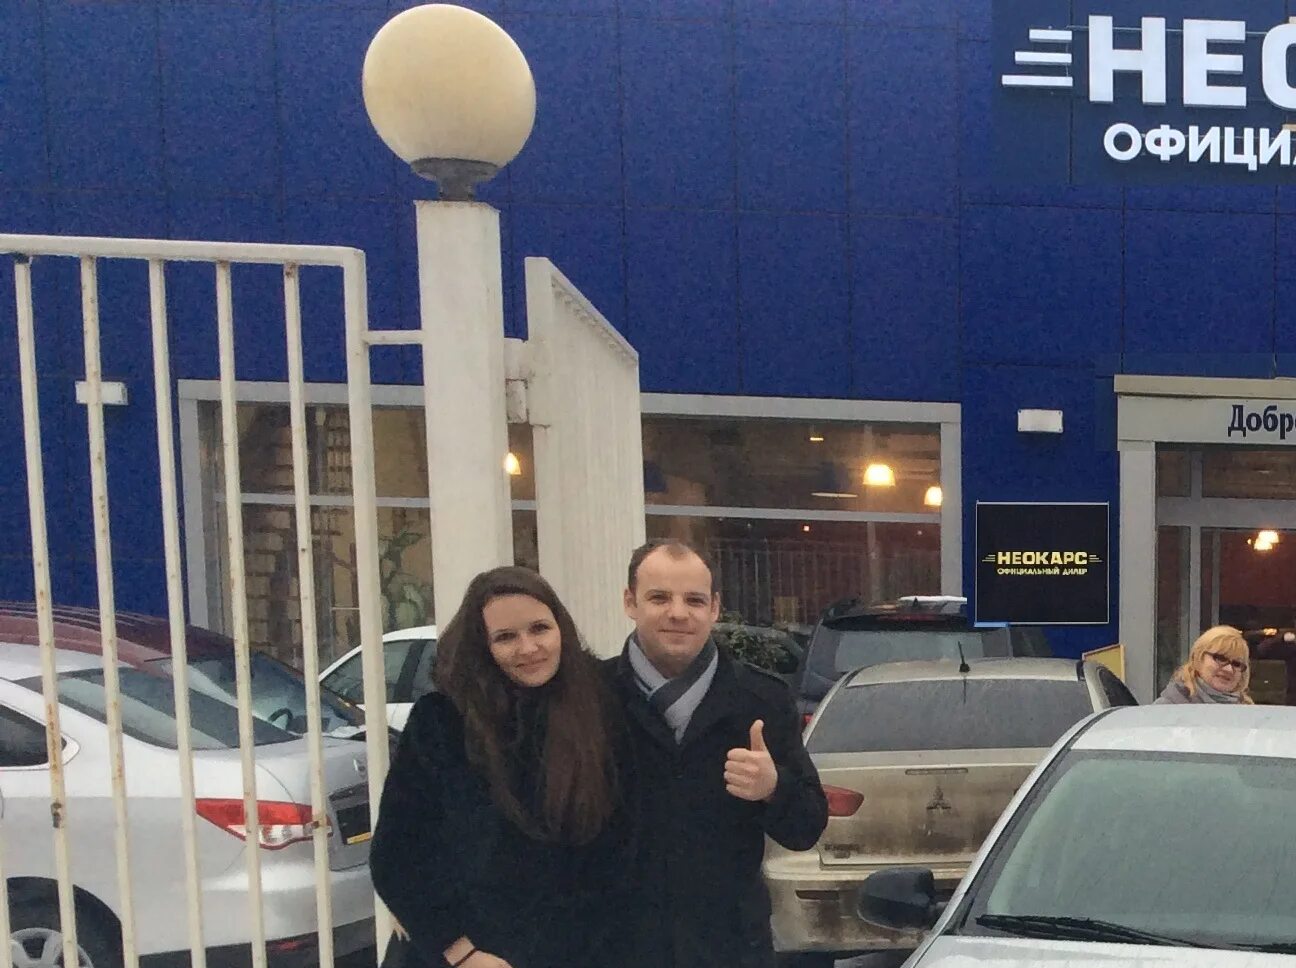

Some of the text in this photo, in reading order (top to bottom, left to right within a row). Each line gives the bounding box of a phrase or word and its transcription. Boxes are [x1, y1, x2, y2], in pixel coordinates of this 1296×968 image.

[997, 551, 1088, 565] НЕОКАРС
[996, 566, 1088, 576] ОФИЦИАЛЬНЫЙ ДИЛЕР
